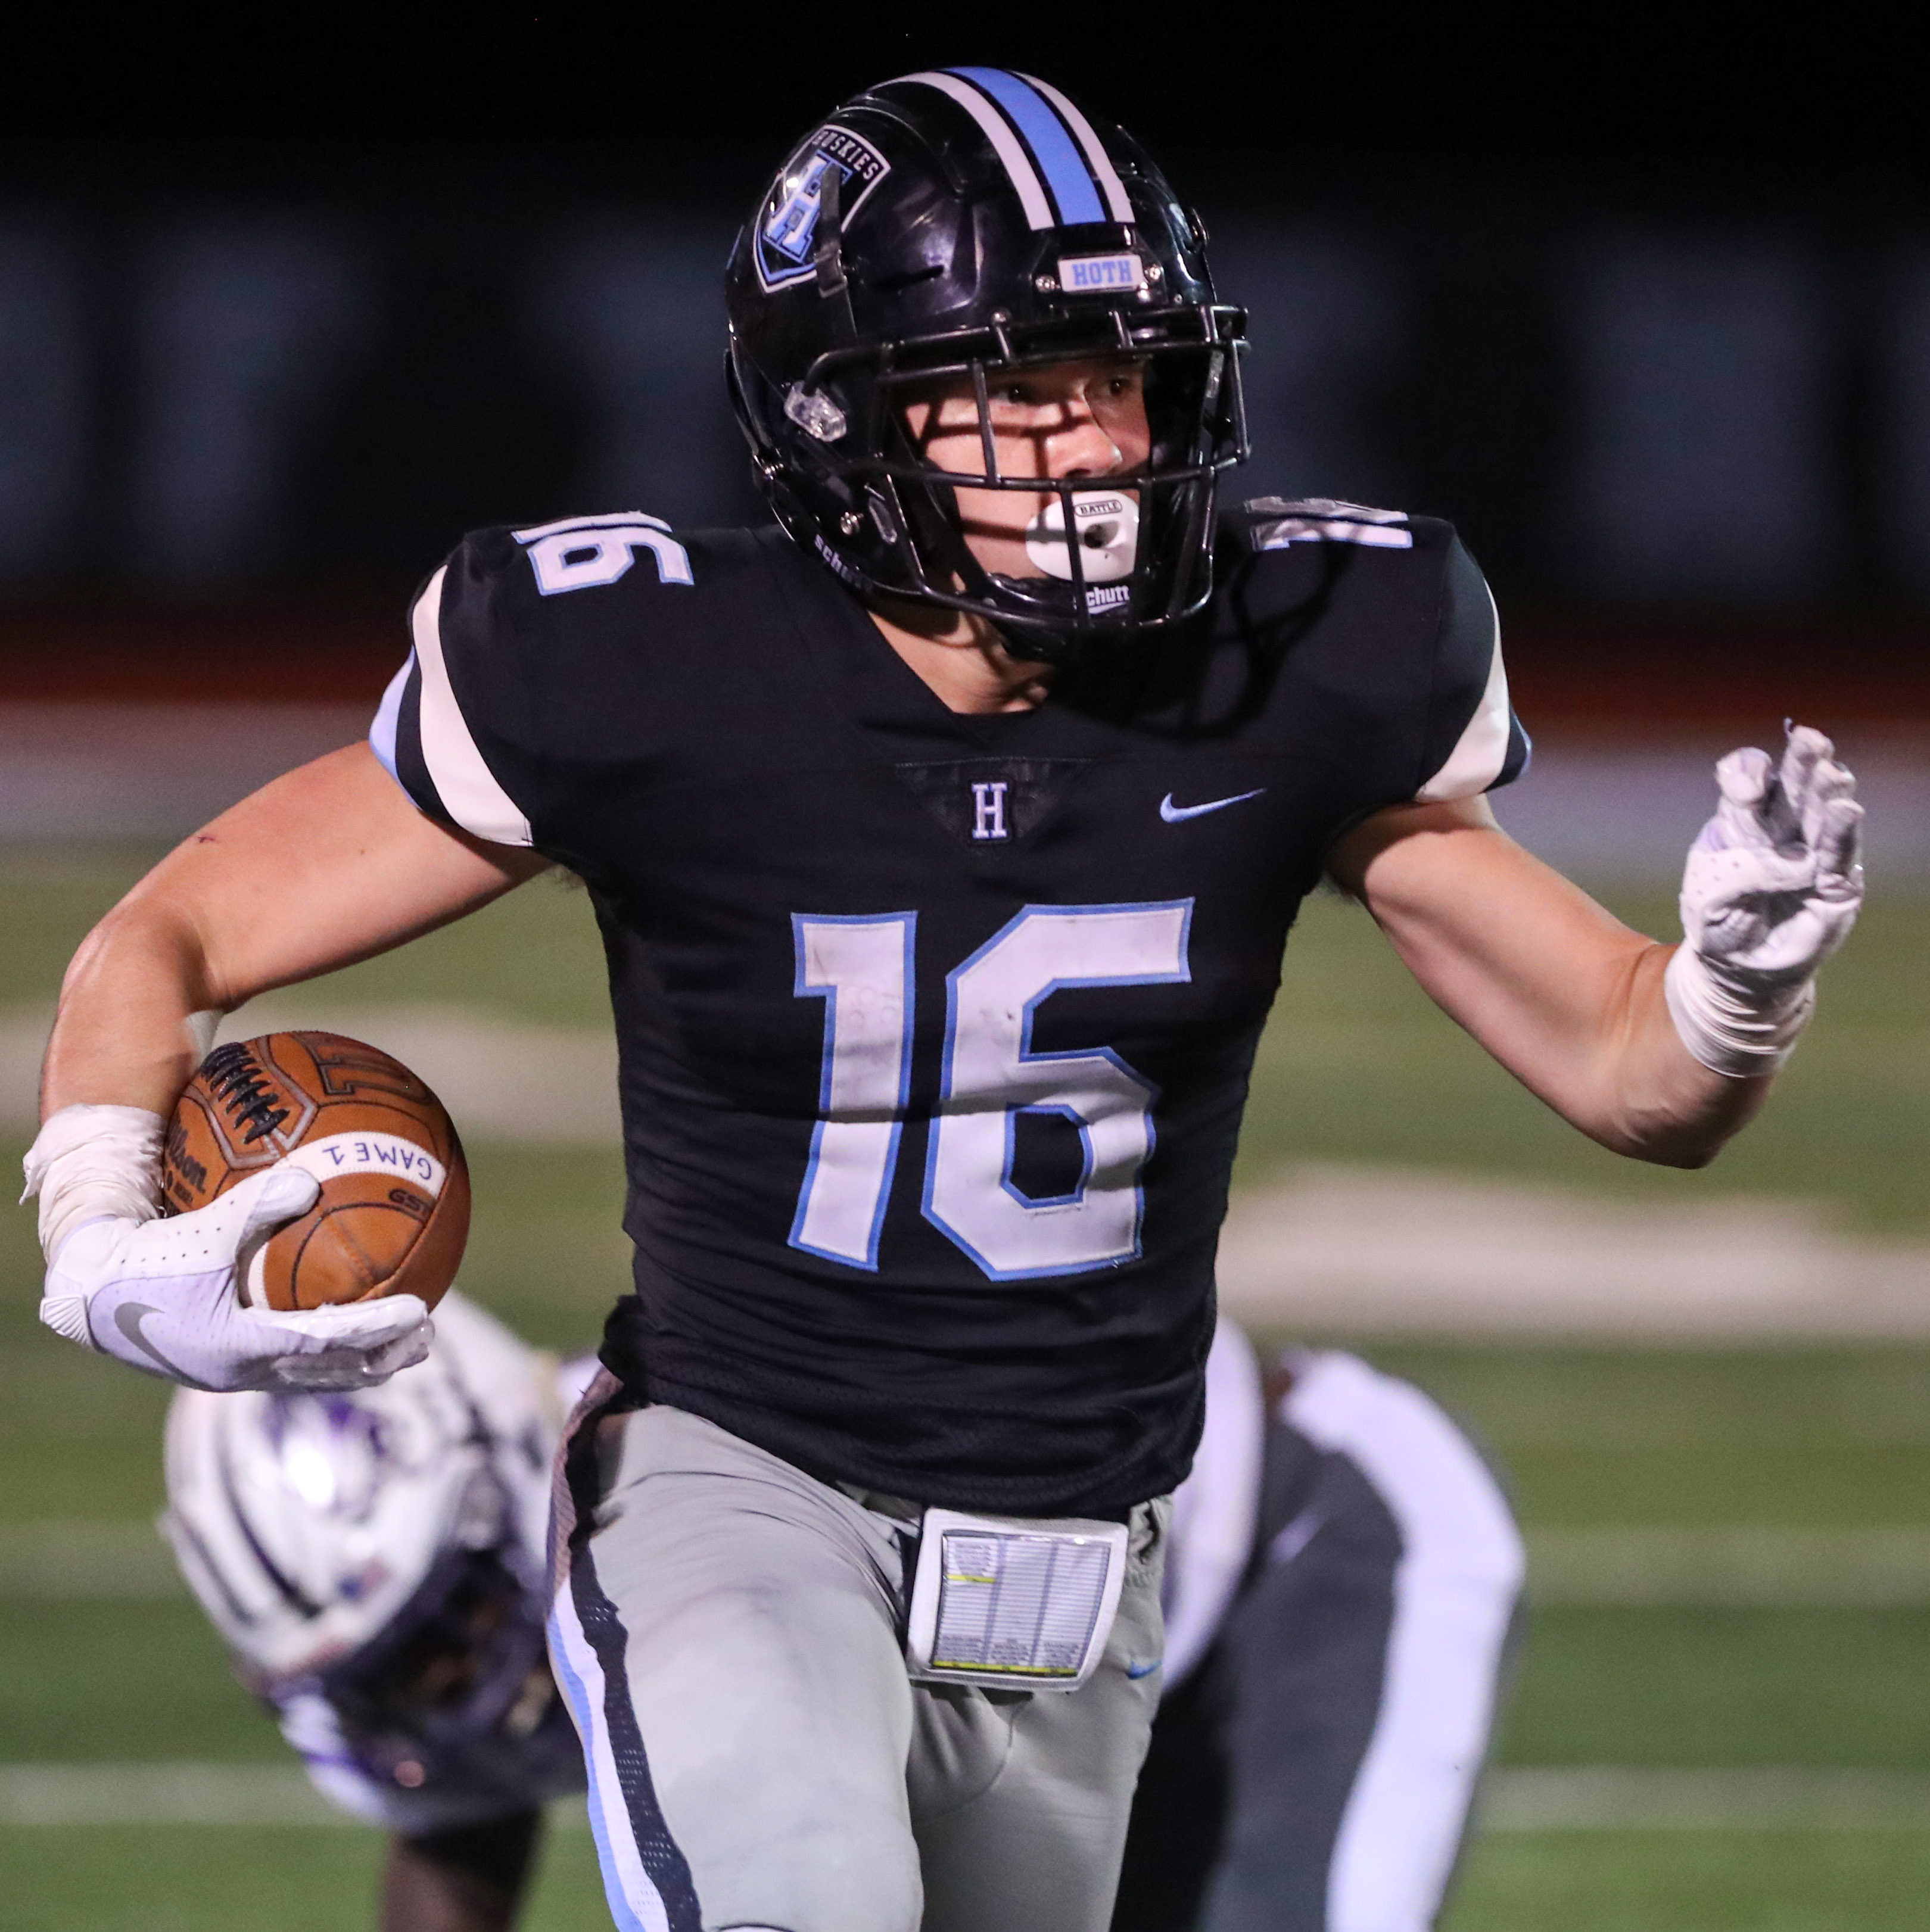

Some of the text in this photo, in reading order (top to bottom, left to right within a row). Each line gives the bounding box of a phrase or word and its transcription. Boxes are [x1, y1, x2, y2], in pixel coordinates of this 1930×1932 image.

[812, 129, 879, 180] HUSKIES
[1073, 260, 1132, 285] HOTH
[1080, 502, 1119, 515] BATTLE
[510, 509, 695, 596] 16
[1085, 584, 1130, 606] chutt
[972, 781, 1008, 840] H
[788, 897, 1195, 1282] 16
[322, 1142, 431, 1180] GAME 1
